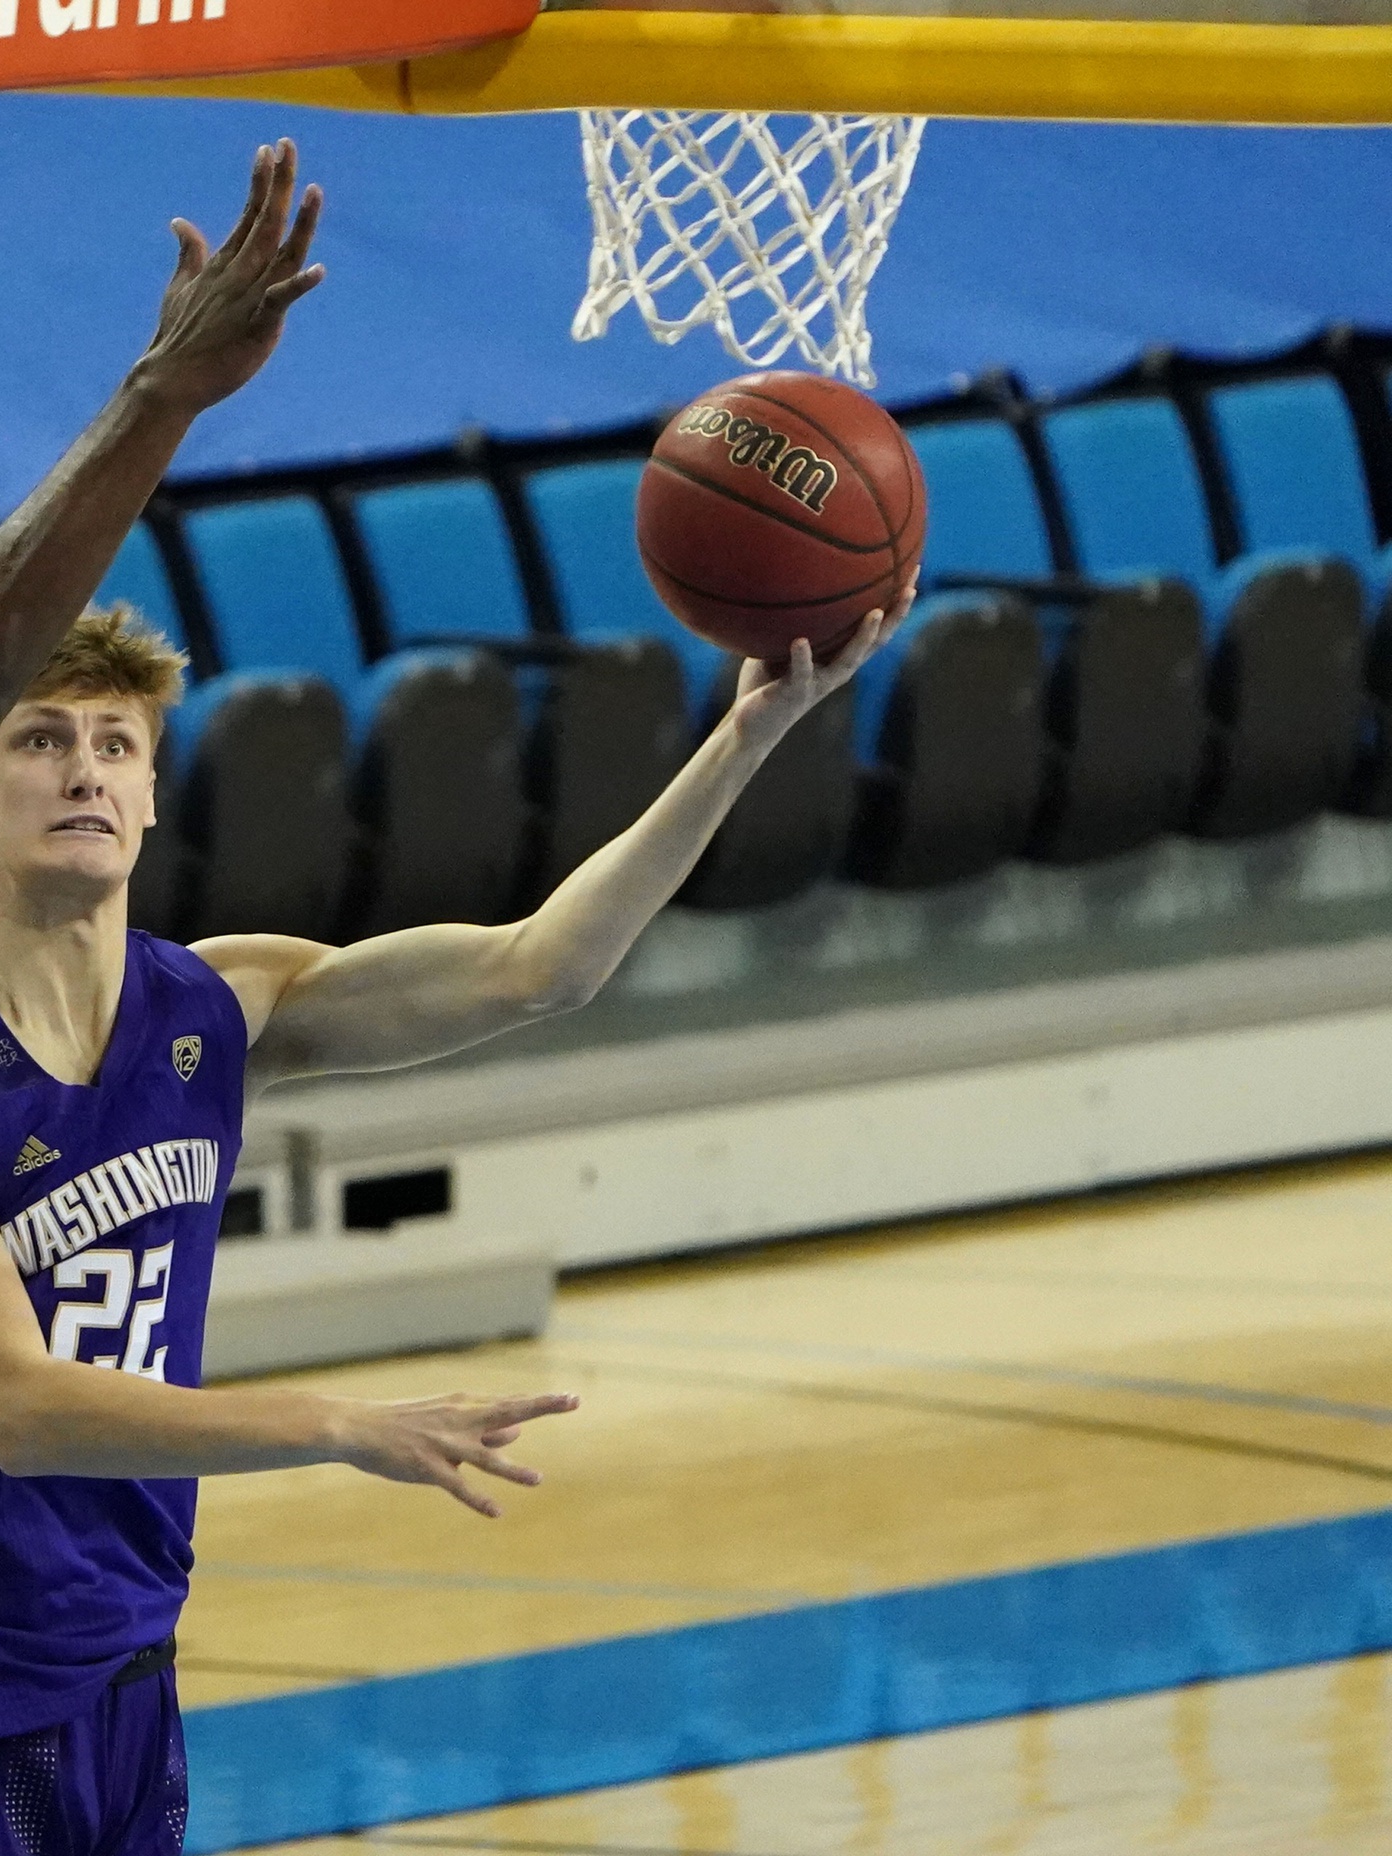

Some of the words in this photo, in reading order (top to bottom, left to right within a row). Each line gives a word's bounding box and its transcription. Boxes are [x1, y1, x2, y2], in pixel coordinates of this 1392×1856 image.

[677, 404, 838, 516] Wilson
[174, 1037, 200, 1064] PAC
[179, 1055, 194, 1071] 12
[12, 1149, 62, 1176] adidas
[48, 1239, 175, 1383] 22
